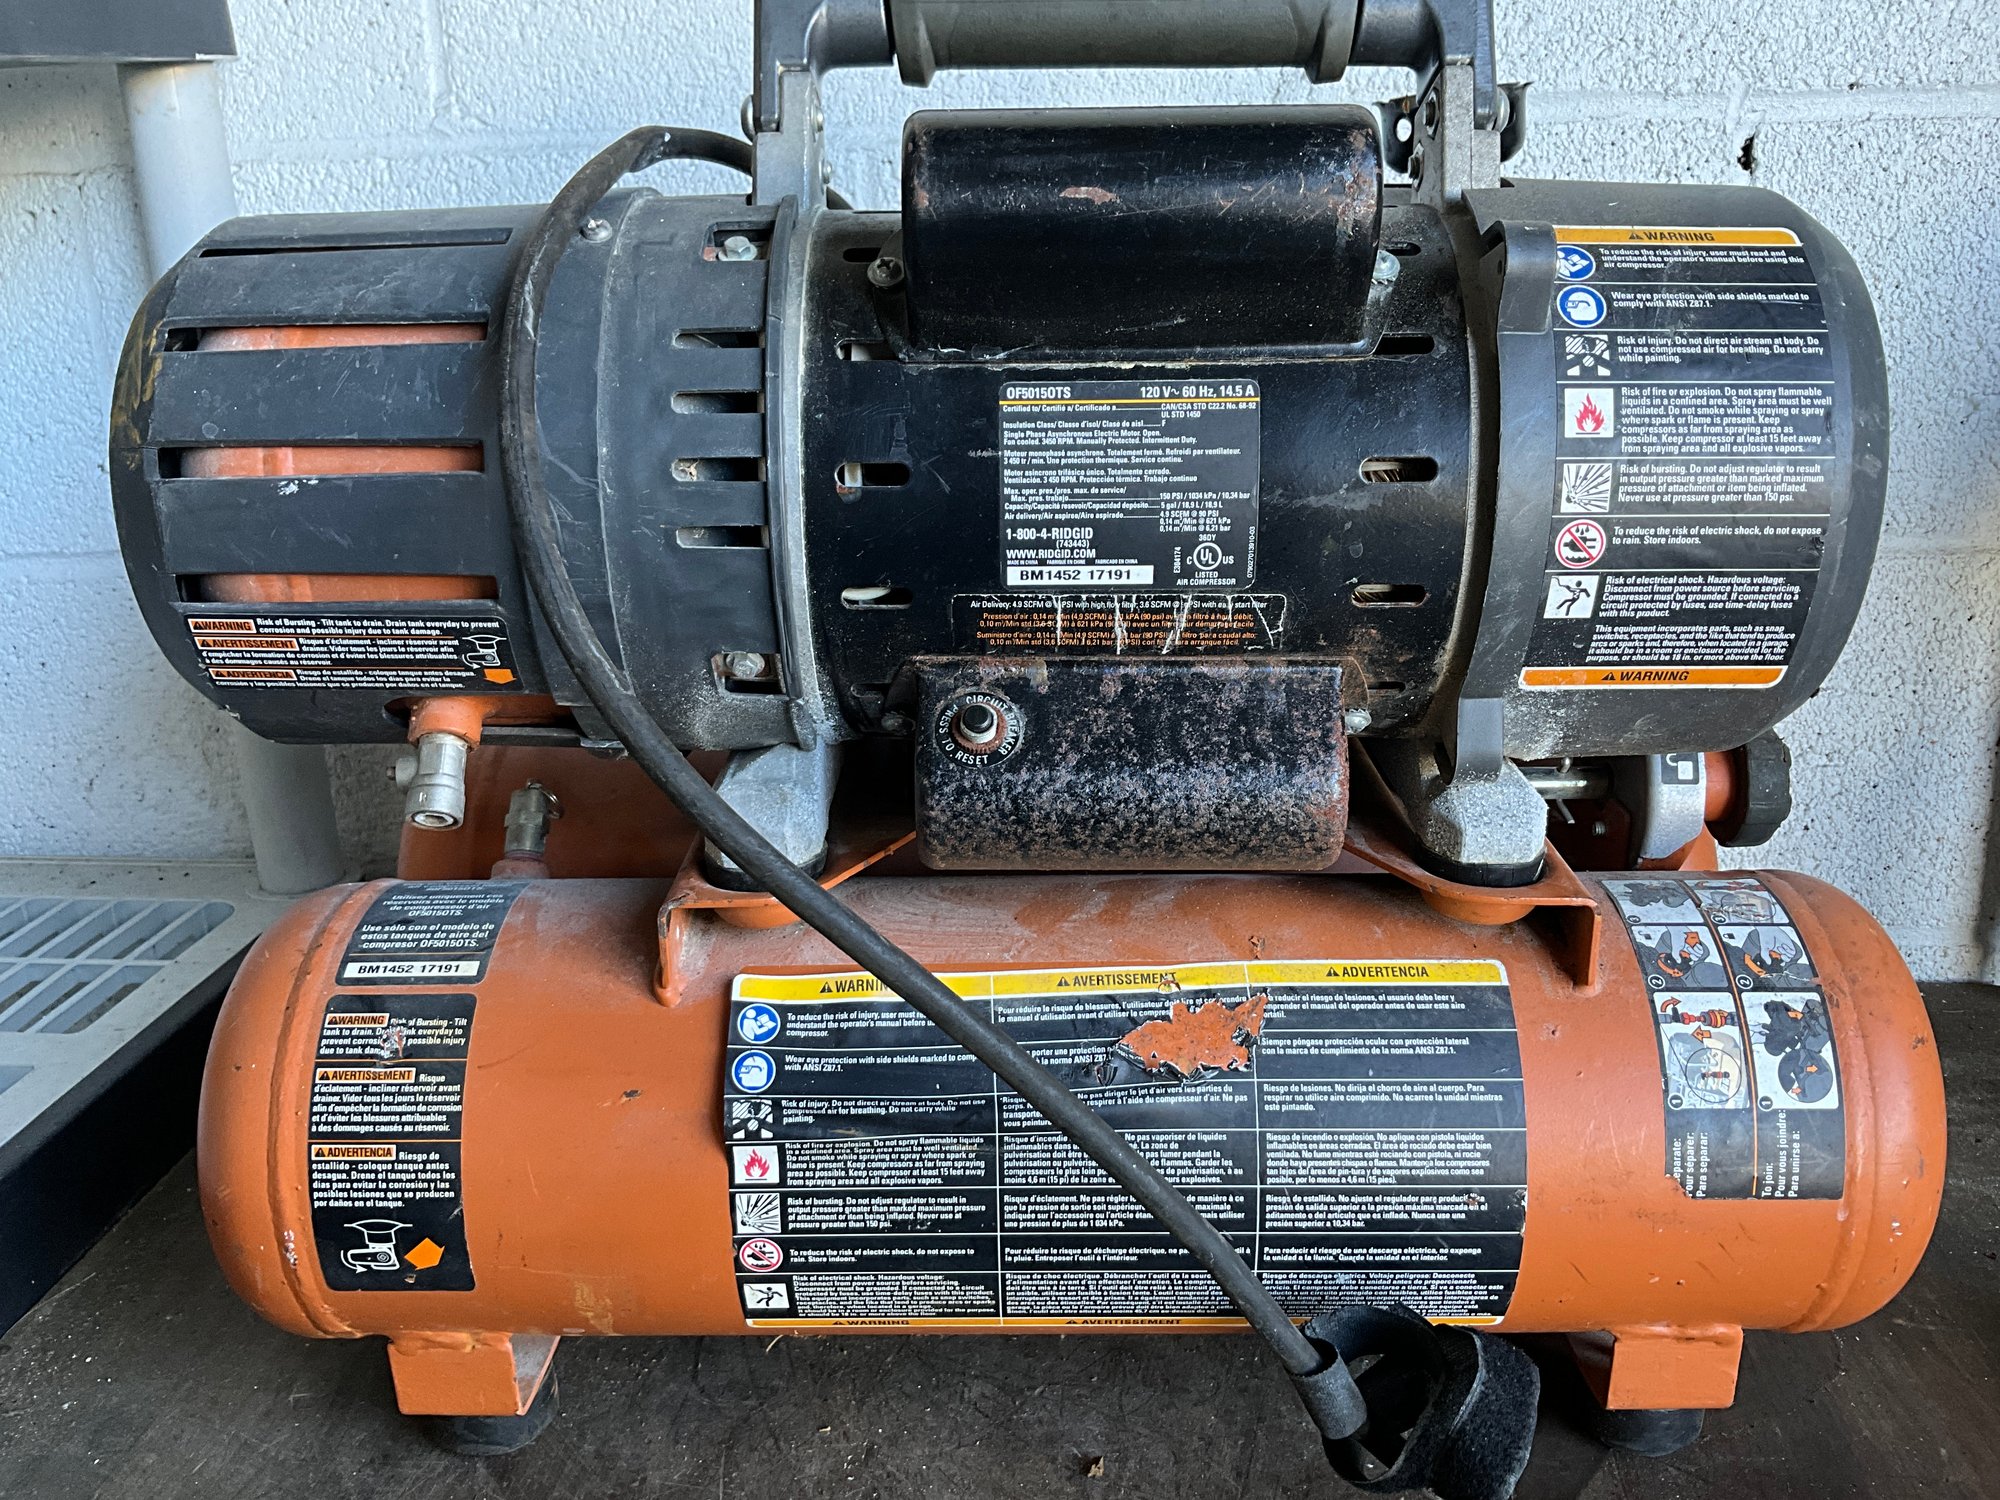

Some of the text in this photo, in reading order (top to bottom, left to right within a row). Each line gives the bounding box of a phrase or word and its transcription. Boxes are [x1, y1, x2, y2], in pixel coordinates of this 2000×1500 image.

[1644, 232, 1714, 242] WARNING
[1611, 291, 1634, 299] Wear
[1635, 293, 1651, 302] eye
[1652, 292, 1696, 302] protection
[1695, 292, 1715, 300] with
[1716, 292, 1735, 300] side
[1736, 292, 1767, 300] shields
[1767, 292, 1799, 300] marked
[1613, 299, 1643, 308] comply
[1140, 386, 1160, 398] 120
[1181, 385, 1196, 397] 60
[1198, 385, 1216, 398] Hz,
[1219, 385, 1242, 396] 14.5
[1244, 385, 1254, 396] A
[1621, 387, 1640, 395] Risk
[1642, 387, 1650, 395] of
[1651, 387, 1666, 395] fire
[1679, 387, 1722, 398] explosion.
[1724, 387, 1736, 395] Do
[1753, 389, 1776, 397] spray
[1777, 387, 1821, 395] flammable
[1161, 402, 1191, 410] CAN/CSA
[1192, 402, 1206, 410] STD
[1003, 430, 1024, 439] Single
[1046, 430, 1092, 439] Asynchronous
[1142, 429, 1161, 438] Open.
[1006, 528, 1093, 539] 1-800-4-RIDGID
[1614, 526, 1821, 536] To reduce the risk of electric shock, do not expose
[1056, 540, 1089, 548] (743443)
[1612, 535, 1701, 544] to rain. Store indoors.
[1006, 549, 1095, 558] WWW.RIDGID.COM
[1187, 549, 1234, 564] C UL US
[1020, 570, 1131, 580] BM1452 17191
[200, 622, 252, 630] WARNING
[256, 617, 273, 625] Risk
[282, 618, 316, 628] Bursting
[320, 618, 334, 626] Tilt
[362, 619, 384, 627] drain.
[384, 619, 406, 627] Drain
[406, 619, 424, 627] tank
[425, 620, 459, 628] everyday
[470, 621, 499, 629] prevent
[212, 639, 293, 649] AVERTISSEMENT
[227, 670, 292, 679] ADVERTENCIA
[1620, 671, 1689, 681] WARNING
[939, 704, 959, 750] PRESS TO
[966, 695, 1017, 755] CIRCUIT BREAKER
[955, 751, 988, 764] RESET
[361, 941, 418, 949] compresor
[357, 964, 459, 973] BM1452 17191
[1342, 966, 1429, 977] ADVERTENCIA
[835, 979, 889, 992] WARNIN
[338, 1016, 384, 1024] WARNING
[1261, 1037, 1291, 1047] Siempre
[1292, 1037, 1323, 1047] póngase
[1324, 1037, 1363, 1047] protección
[1364, 1037, 1388, 1045] ocular
[1404, 1037, 1444, 1047] protección
[1444, 1037, 1469, 1045] lateral
[332, 1071, 445, 1084] AVERTISSEMENT Risque
[328, 1148, 439, 1161] ADVERTENCIA Riesgo de
[1775, 1110, 1789, 1197] Pour vous joindre:
[1696, 1132, 1710, 1197] Para separar:
[1788, 1130, 1800, 1197] Para unirse a:
[804, 1178, 836, 1186] spraying
[880, 1177, 916, 1185] explosive
[916, 1177, 943, 1185] vapors.
[1762, 1163, 1774, 1197] To join:
